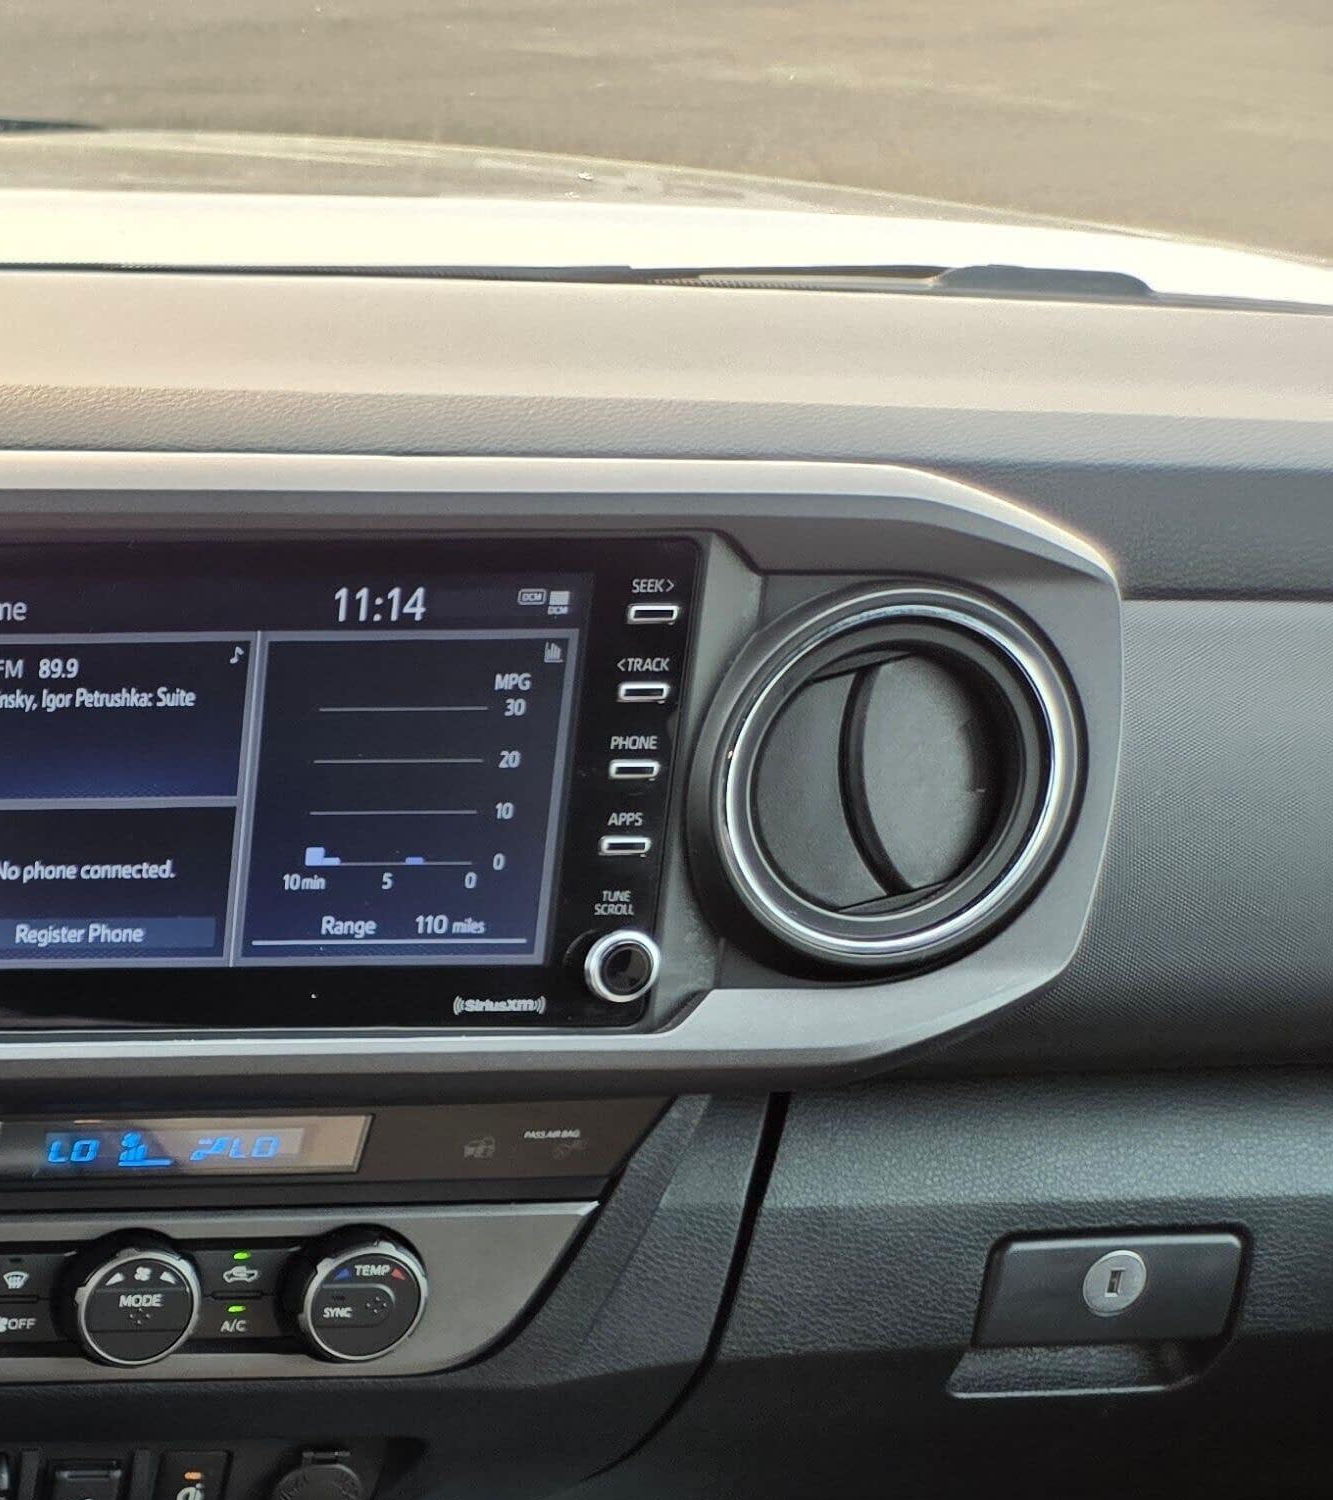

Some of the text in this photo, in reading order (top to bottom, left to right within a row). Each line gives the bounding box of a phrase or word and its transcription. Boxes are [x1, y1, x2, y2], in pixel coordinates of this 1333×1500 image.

[334, 586, 427, 623] 11:14
[38, 658, 79, 679] 89.9
[494, 674, 531, 691] MPG
[42, 688, 73, 711] Igor
[75, 687, 152, 709] Petrushka:
[156, 688, 196, 708] Suite
[504, 699, 526, 717] 30
[610, 736, 657, 750] PHONE
[498, 751, 521, 769] 20
[495, 803, 514, 819] 10
[608, 812, 643, 827] APPS
[493, 854, 505, 870] 0
[23, 861, 77, 884] phone
[80, 859, 175, 881] connected.
[382, 873, 393, 889] 5
[464, 873, 476, 889] 0
[602, 890, 631, 903] TUNE
[594, 903, 634, 916] SCROLL
[321, 915, 485, 938] Range 110 miles
[15, 924, 145, 947] Register Phone
[46, 1139, 100, 1163] LO
[354, 1264, 391, 1277] TEMP
[118, 1294, 164, 1308] MODE
[323, 1307, 353, 1319] SYNC
[8, 1318, 37, 1330] OFF
[220, 1319, 247, 1333] A/C
